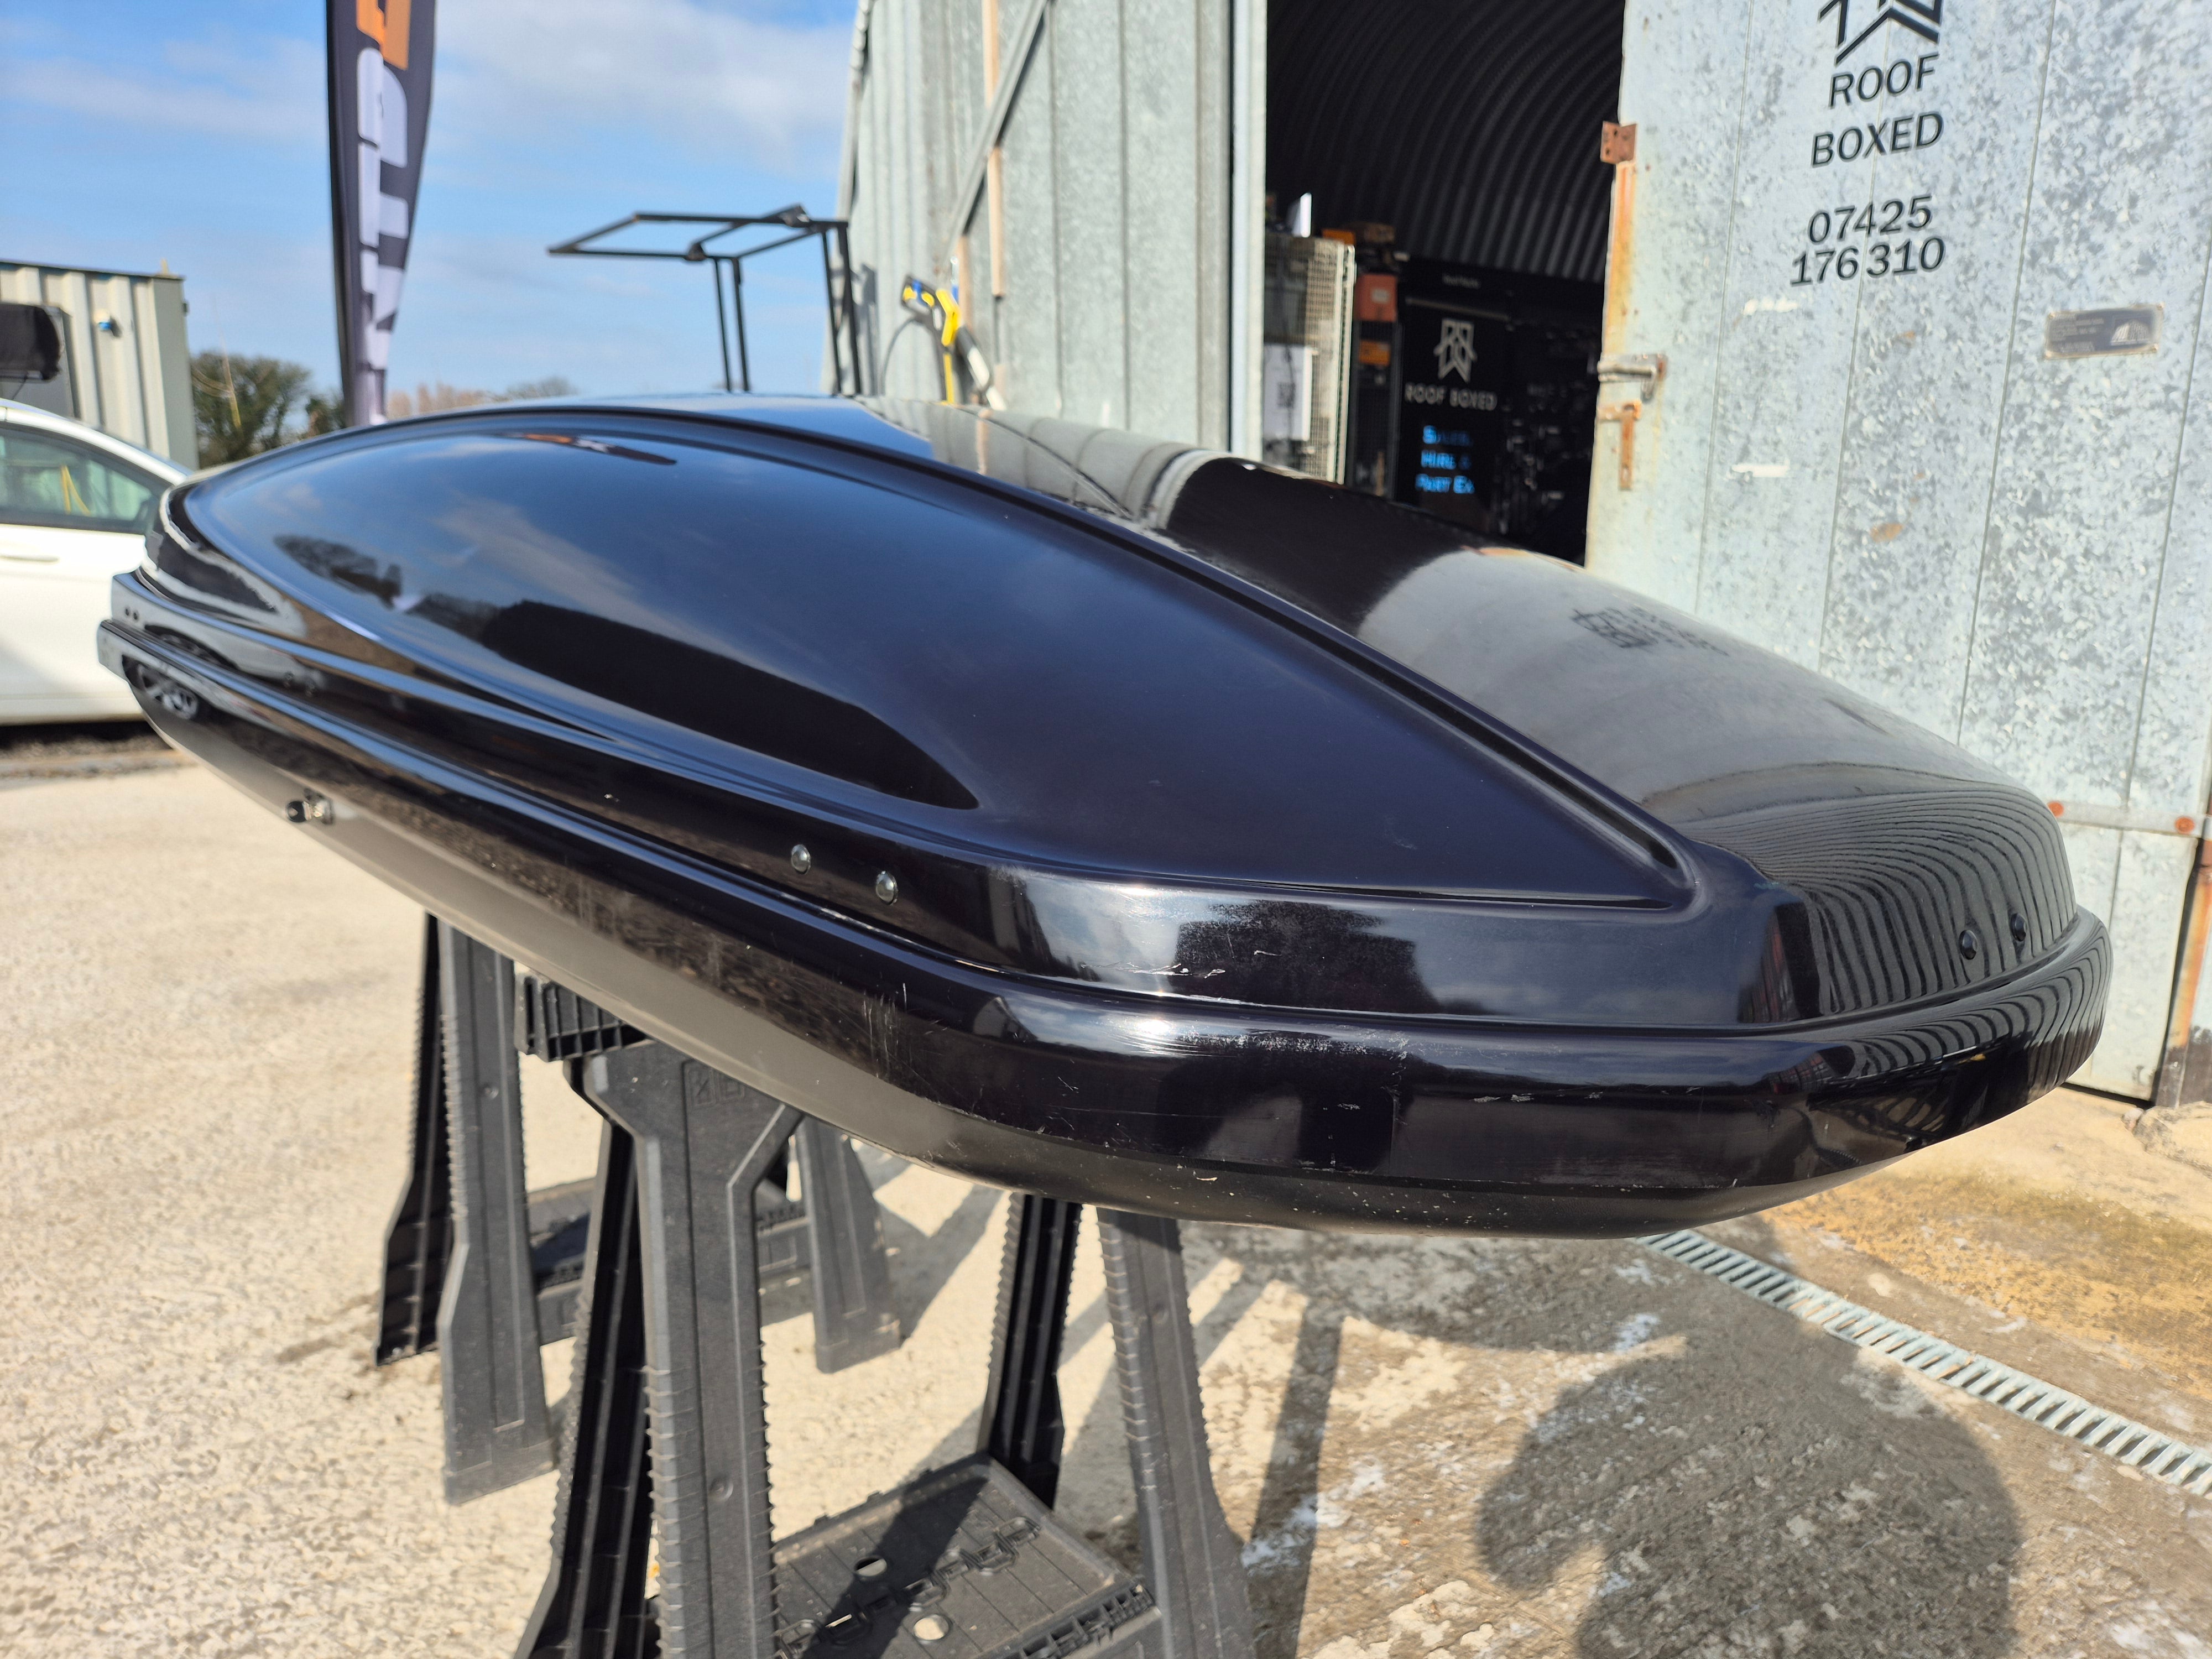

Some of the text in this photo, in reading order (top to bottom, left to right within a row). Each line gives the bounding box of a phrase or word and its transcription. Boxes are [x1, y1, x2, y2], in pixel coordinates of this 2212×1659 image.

[1828, 51, 1939, 109] ROOF
[1811, 111, 1944, 168] BOXED
[1807, 194, 1932, 245] 07425
